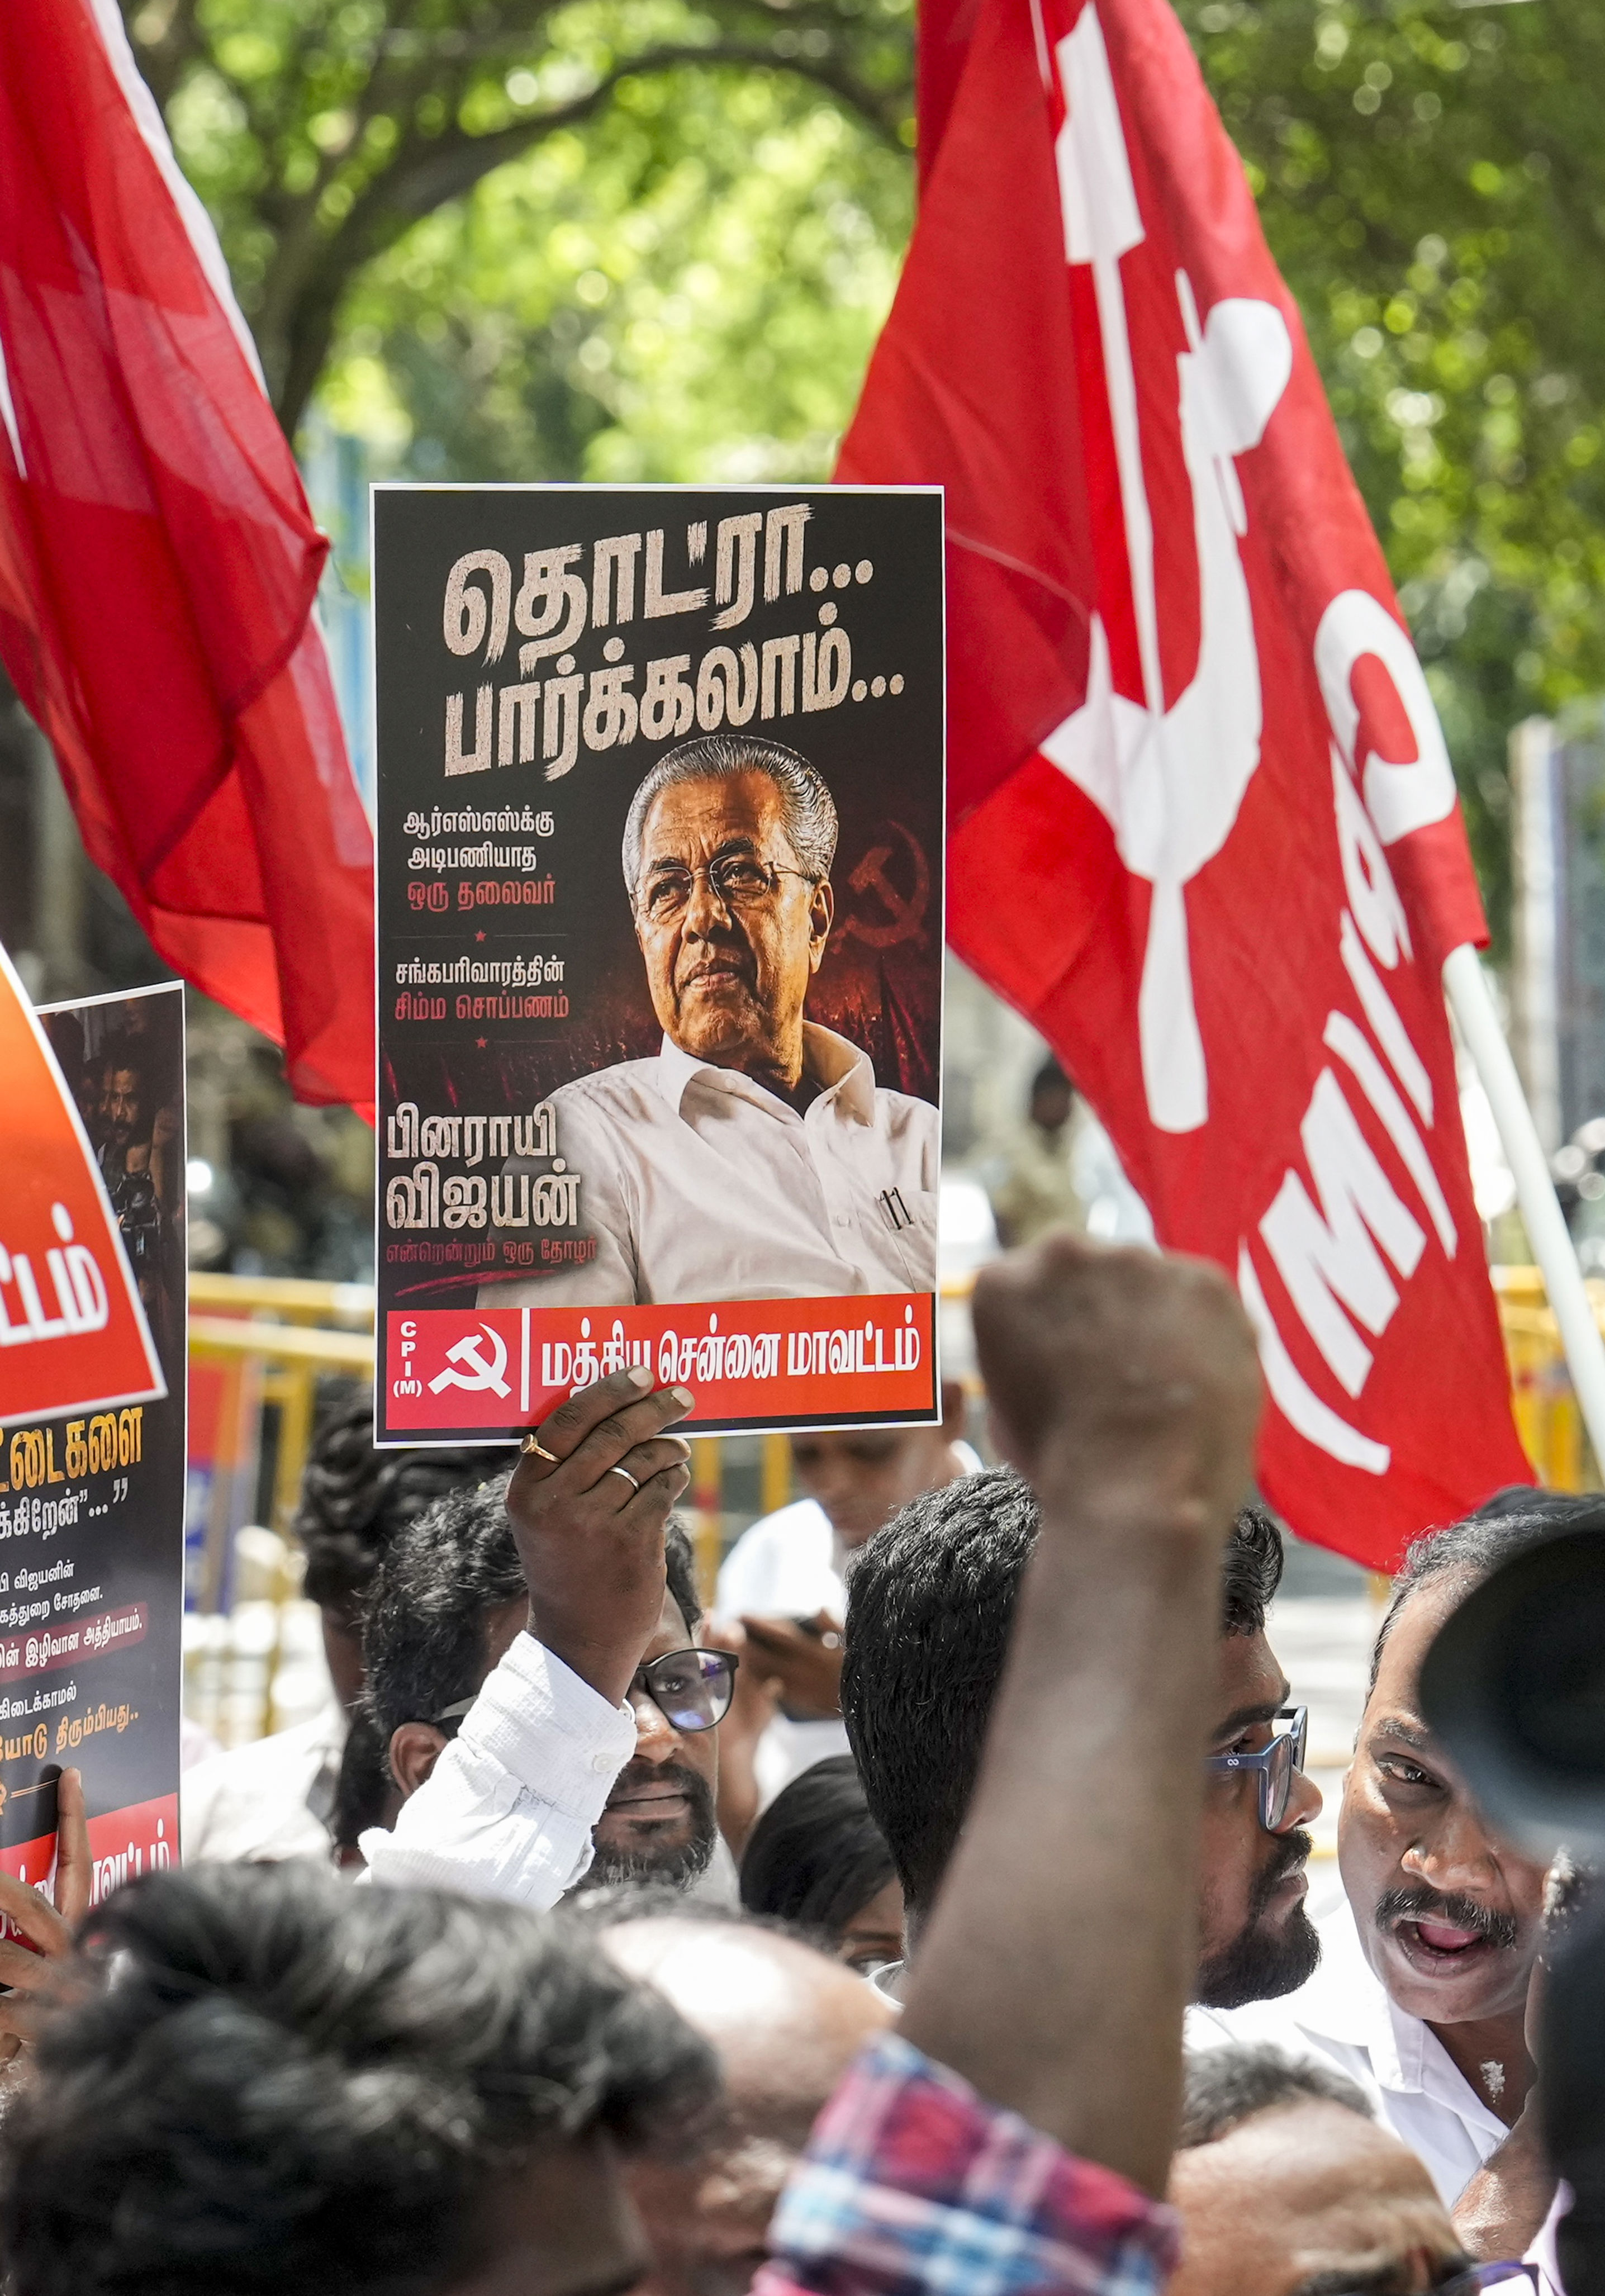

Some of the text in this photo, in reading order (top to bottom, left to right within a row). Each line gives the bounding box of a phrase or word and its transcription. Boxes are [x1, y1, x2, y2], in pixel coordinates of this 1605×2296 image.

[444, 601, 905, 782] பார்க்கலாம்...
[403, 805, 554, 839] ஆர்எஸ்எஸ்க்கு
[407, 841, 536, 873] அடிபணியாத
[407, 874, 555, 912] ஒரு தலைவர்
[395, 955, 564, 987] சங்கபரிவாரத்தின்
[395, 989, 569, 1020] சிம்ம சொப்பணம்
[387, 1101, 557, 1168] பினராயி
[386, 1158, 581, 1229] விஜயன்
[386, 1235, 597, 1268] என்றென்றும் ஒரு தோழர்
[658, 1312, 781, 1384] சென்னை
[787, 1304, 920, 1376] மாவட்டம்
[0, 1406, 143, 1493] டைகளை
[14, 1559, 74, 1592] விஜயனின்
[25, 1632, 79, 1667] இழிவான
[83, 1608, 142, 1650] அத்தியாயம்.
